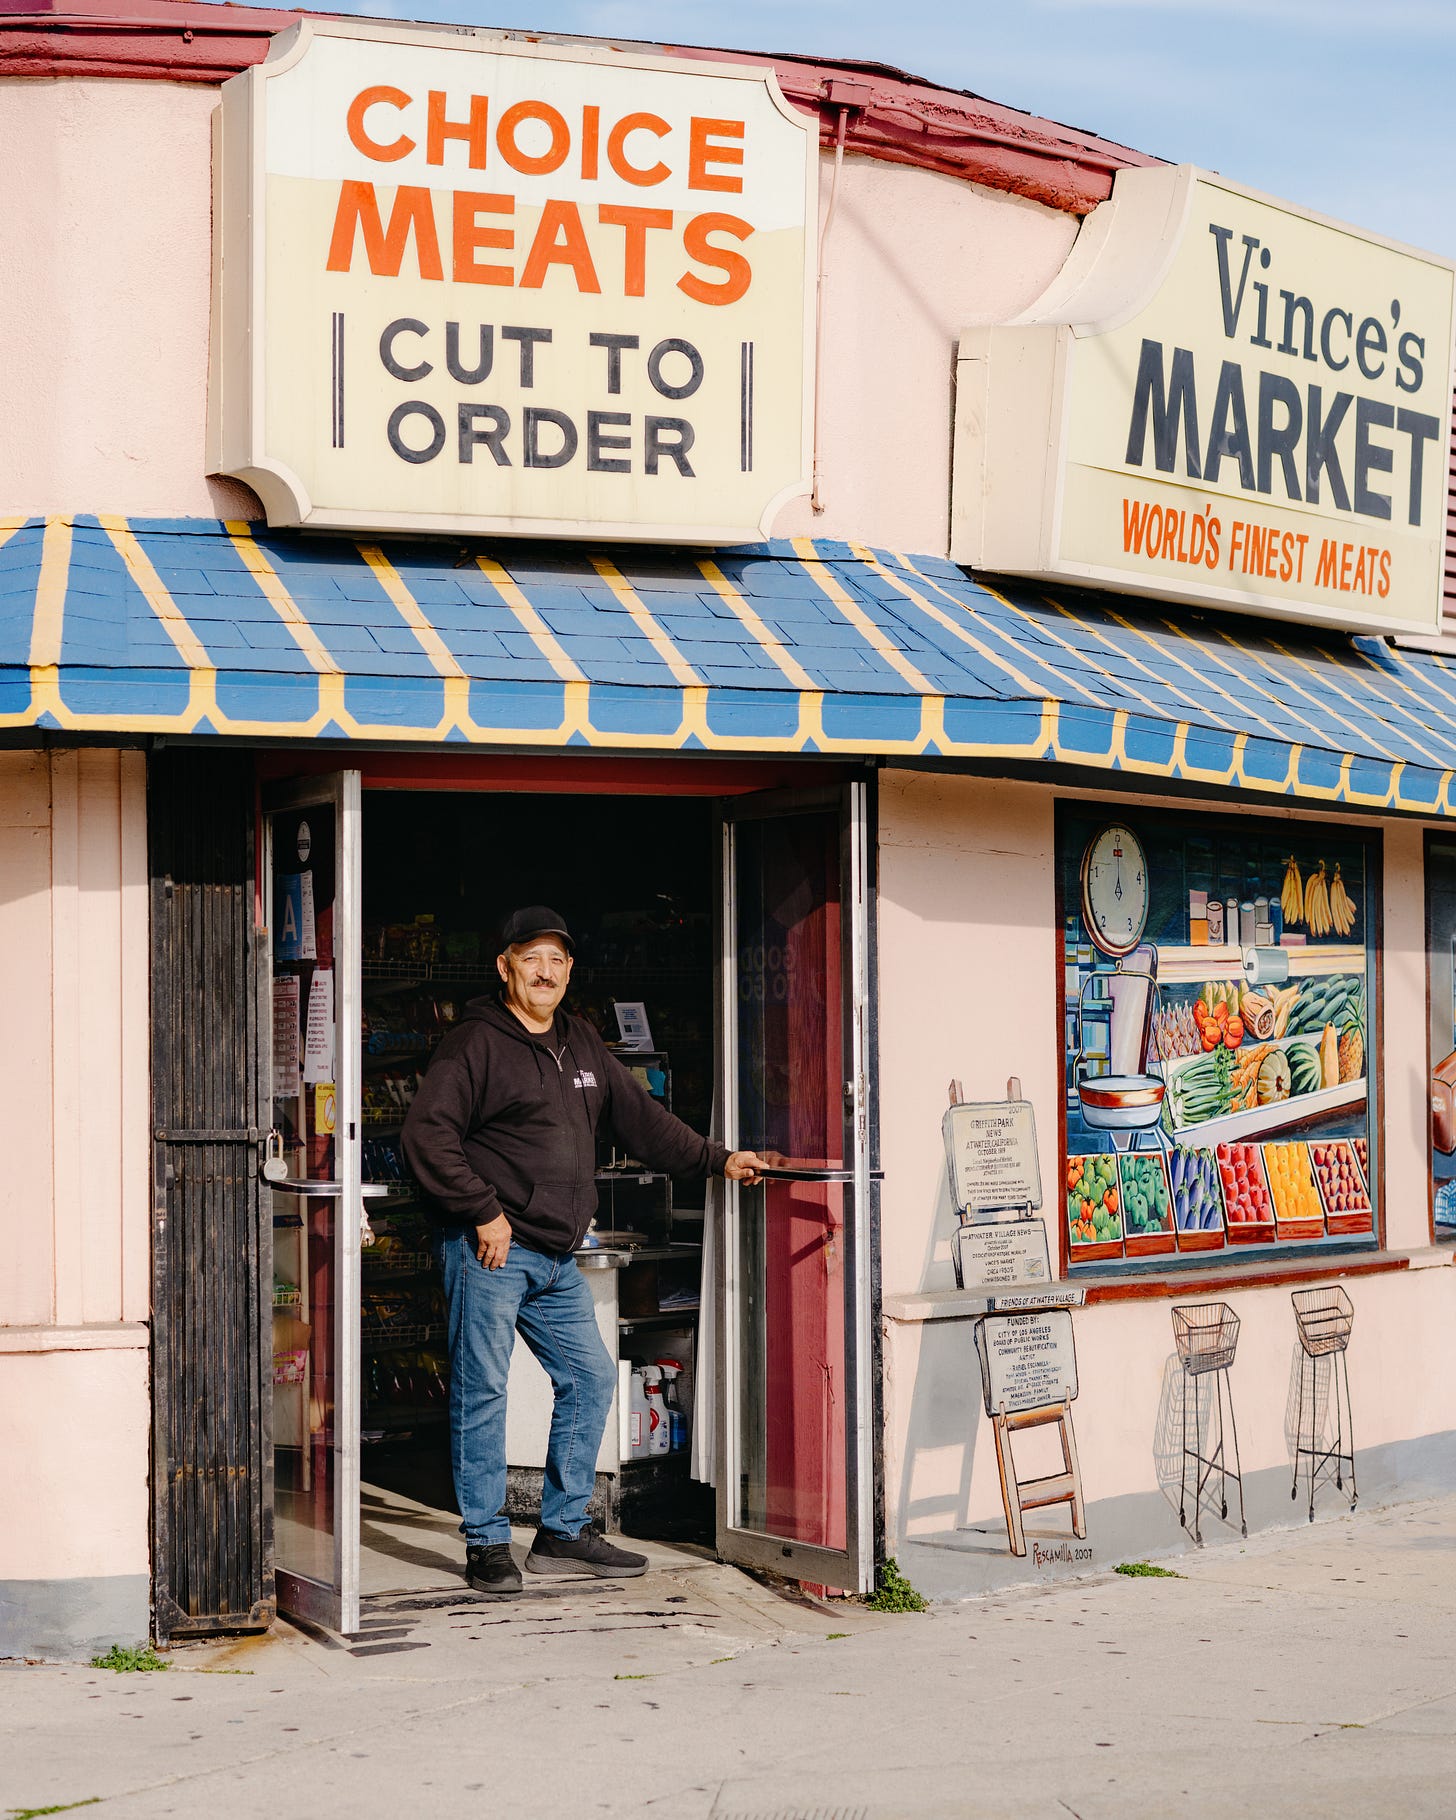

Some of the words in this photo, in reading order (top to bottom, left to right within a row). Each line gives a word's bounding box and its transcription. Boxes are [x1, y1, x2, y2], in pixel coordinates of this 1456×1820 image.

[347, 85, 745, 194] CHOICE
[326, 179, 755, 306] MEATS
[1209, 223, 1425, 394] Vince's
[379, 318, 553, 389] CUT
[589, 332, 705, 400] TO
[386, 400, 697, 479] ORDER
[1125, 338, 1440, 527] MARKET
[1122, 498, 1222, 570] WORLD'S
[1229, 521, 1309, 583] FINEST
[1314, 538, 1392, 599] MEATS
[281, 894, 298, 942] A
[1101, 915, 1106, 928] 2
[1127, 918, 1133, 932] 3
[997, 1118, 1014, 1128] PARK
[986, 1129, 1002, 1138] NEWS
[968, 1232, 993, 1240] ATWATER
[995, 1230, 1016, 1238] VILLAGE
[1001, 1298, 1022, 1307] FRIENDS
[1030, 1295, 1054, 1305] ATWATER
[1055, 1293, 1075, 1303] VILLAGE
[1007, 1317, 1029, 1326] FUNDED
[998, 1330, 1010, 1338] CITY
[1019, 1328, 1028, 1336] LOS
[1029, 1326, 1051, 1335] ANGELES
[1014, 1336, 1031, 1344] PUBLIC
[1032, 1334, 1049, 1342] WORKS
[1023, 1342, 1057, 1353] BEAUTIFICATION
[1075, 1548, 1093, 1560] 2007
